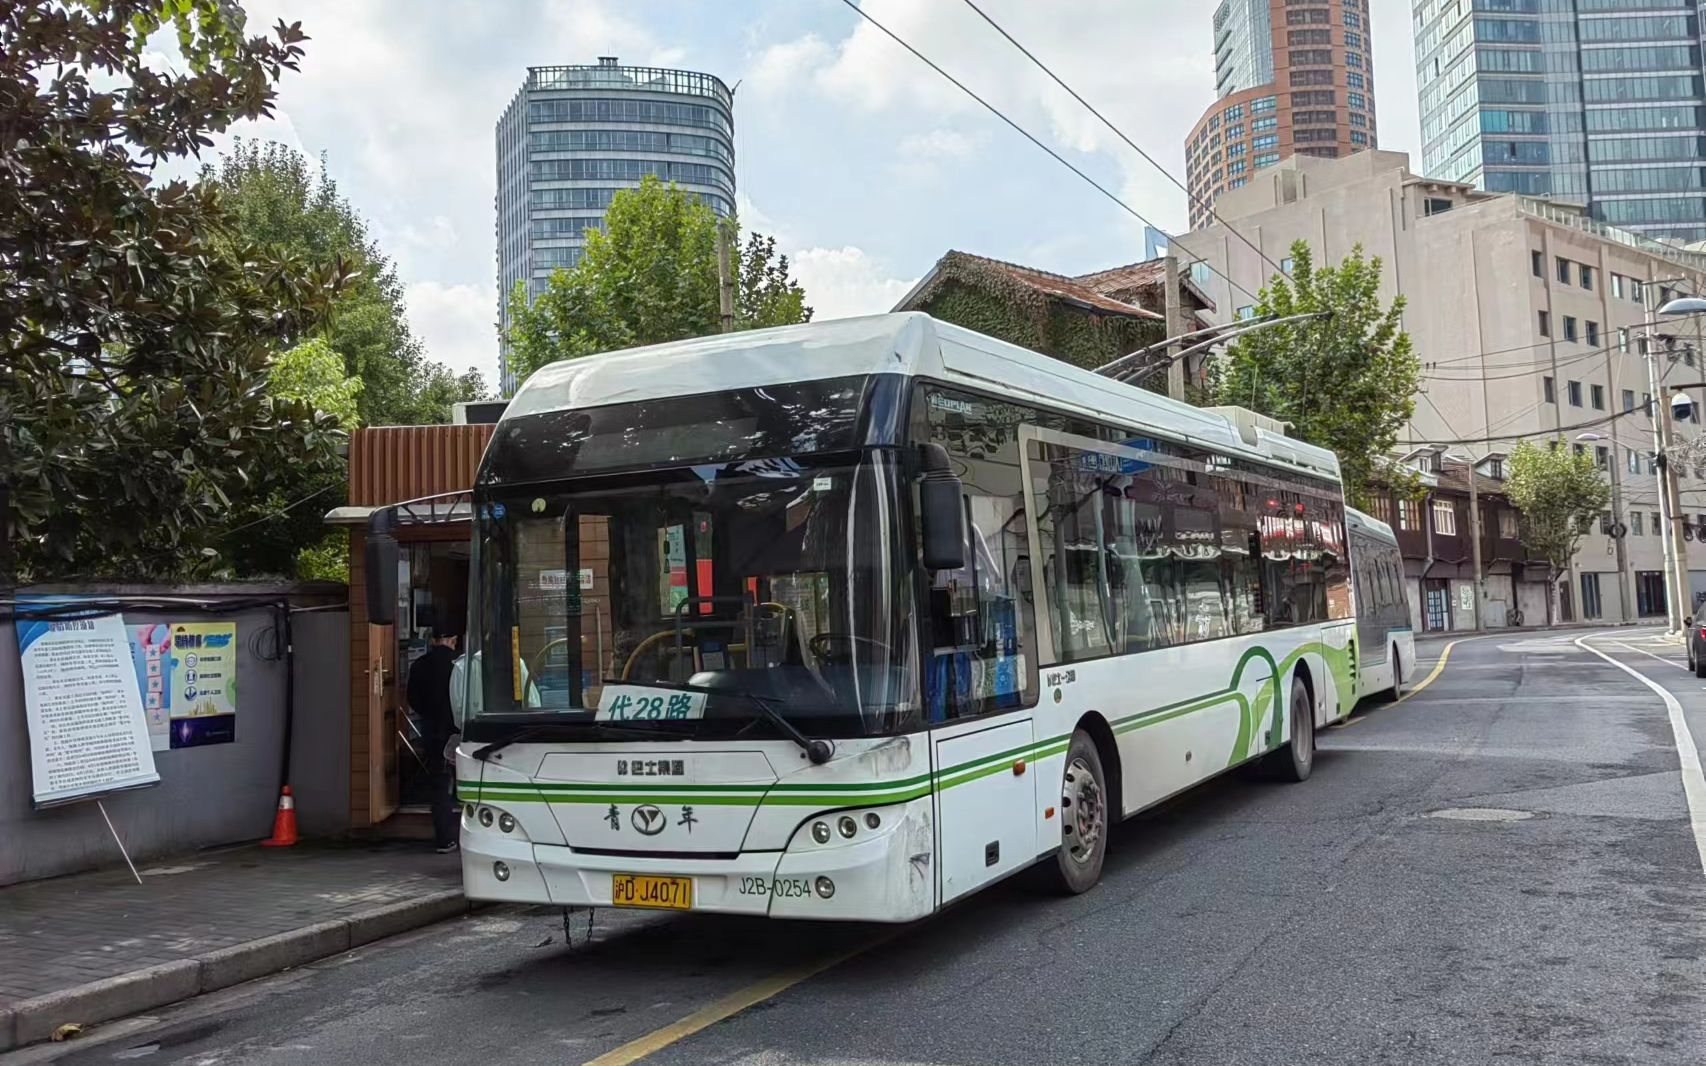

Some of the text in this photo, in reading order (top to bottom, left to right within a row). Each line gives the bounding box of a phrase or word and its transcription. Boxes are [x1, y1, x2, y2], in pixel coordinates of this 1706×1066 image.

[631, 760, 685, 776] 巴士集团
[739, 876, 812, 898] J2B-0254
